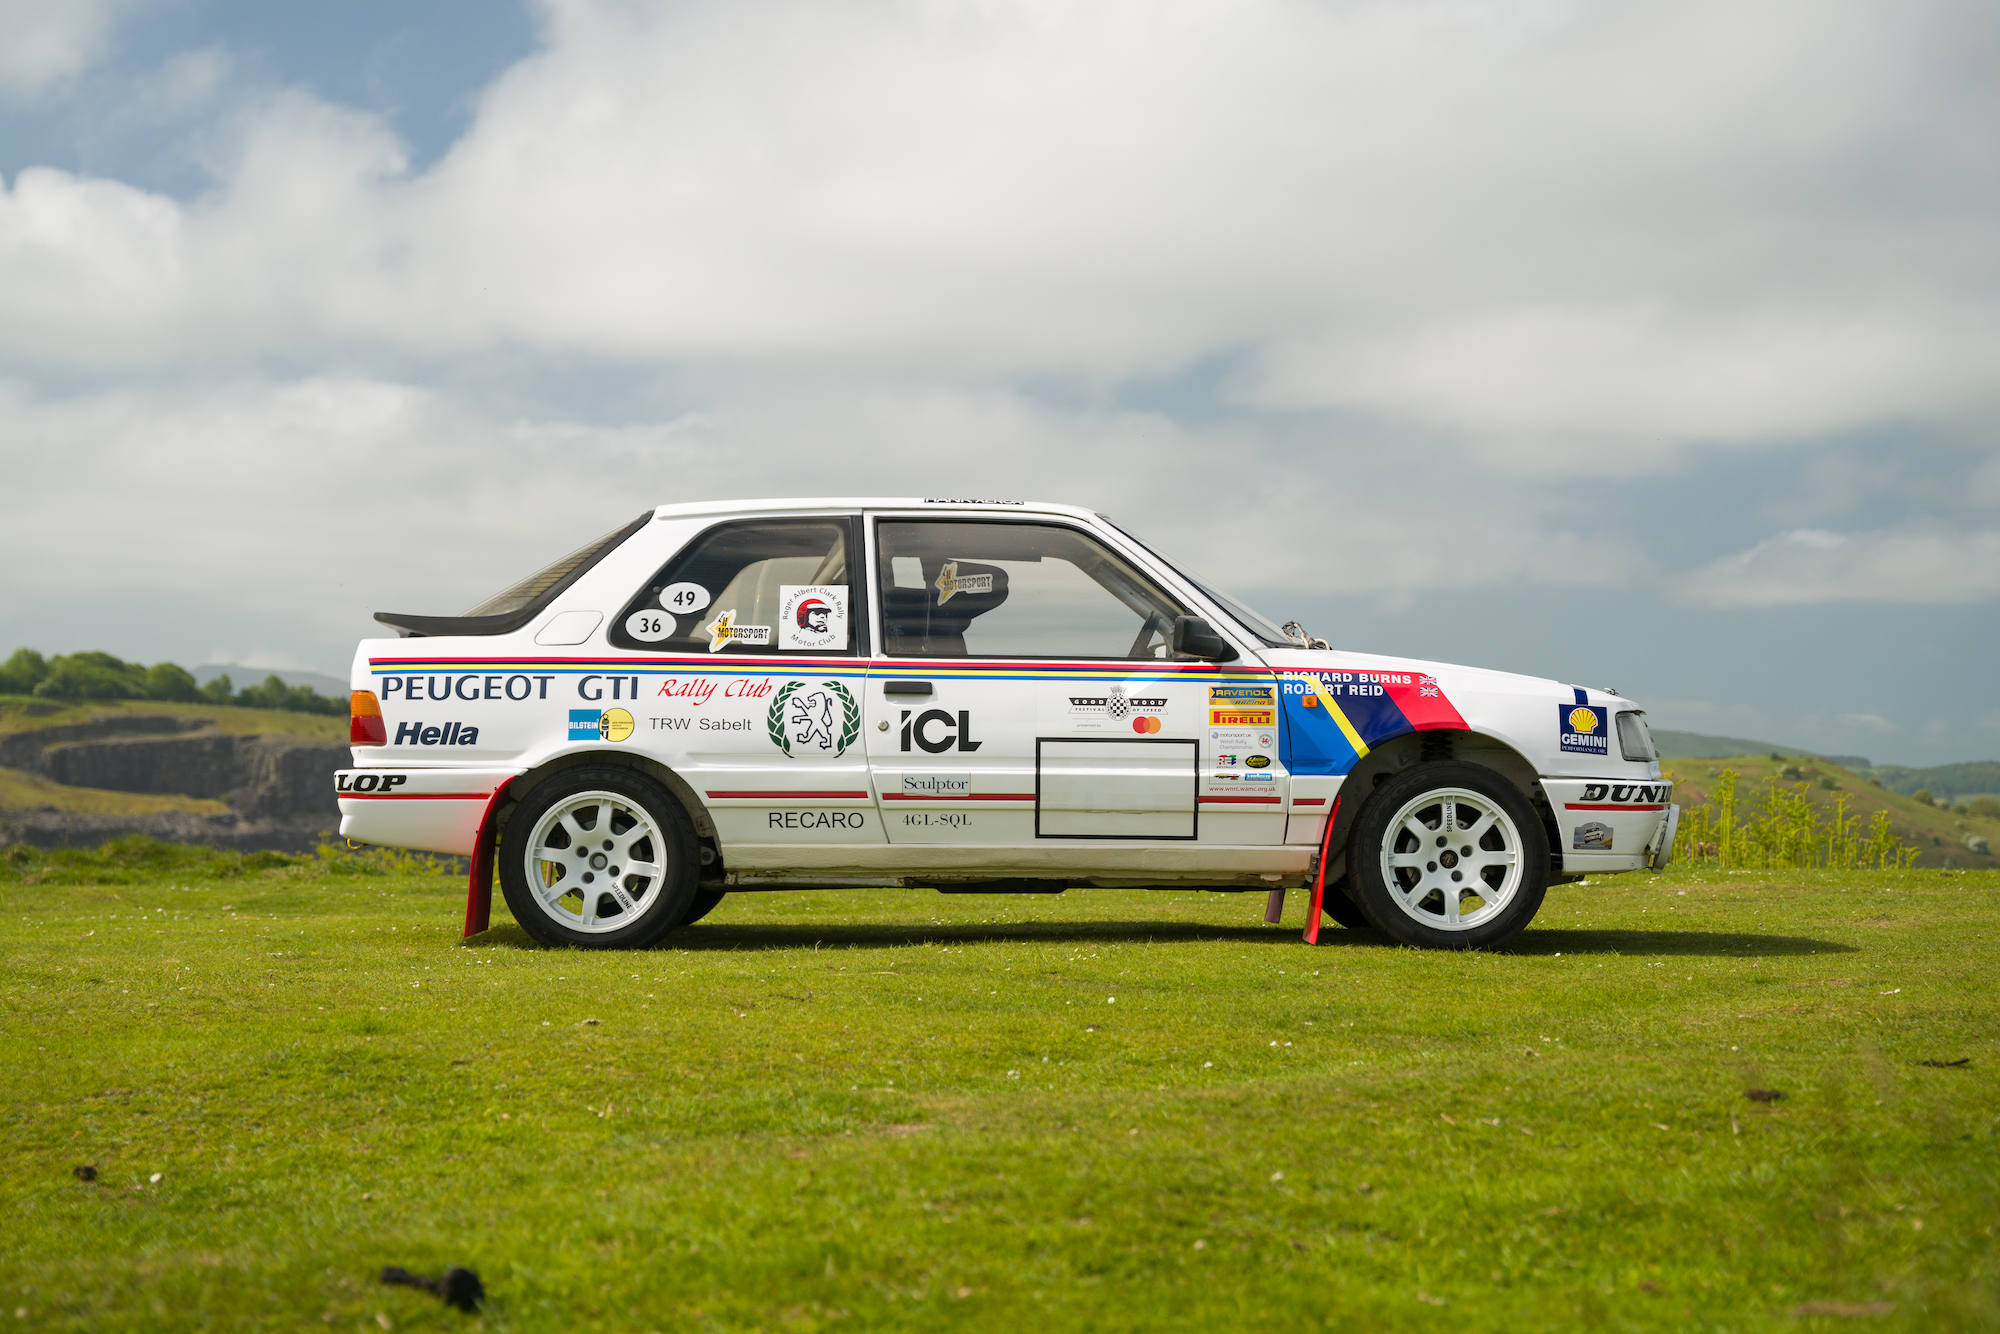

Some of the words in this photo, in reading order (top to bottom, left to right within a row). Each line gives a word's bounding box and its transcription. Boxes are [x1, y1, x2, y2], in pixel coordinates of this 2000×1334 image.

[944, 576, 991, 591] MOTORSPORT
[673, 591, 696, 606] 49
[782, 599, 794, 620] Roger
[793, 587, 817, 599] Albert
[819, 588, 837, 601] Clark
[835, 601, 845, 619] Rally
[639, 618, 661, 633] 36
[717, 627, 769, 639] MOTORSPORT
[791, 634, 815, 647] Motor
[818, 634, 836, 646] Club
[1283, 671, 1353, 683] RICHARD
[1359, 673, 1412, 684] BURNS
[381, 675, 555, 701] PEUGEOT
[578, 675, 638, 700] GTI
[657, 678, 718, 706] Rally
[724, 677, 773, 699] Club
[1283, 683, 1343, 695] ROBERT
[1349, 685, 1384, 696] REID
[649, 718, 691, 730] TRW
[699, 717, 752, 731] Sabelt
[1214, 711, 1271, 724] PIRELLI
[569, 721, 599, 730] BILSTEIN
[900, 709, 983, 754] ICL
[394, 722, 479, 746] Hella
[1561, 733, 1607, 748] GEMINI
[334, 774, 407, 791] LOP
[904, 776, 968, 793] Sculptor
[768, 812, 864, 829] RECARO
[903, 813, 972, 829] 4GL-SQL
[611, 882, 633, 909] SPEEDLINE
